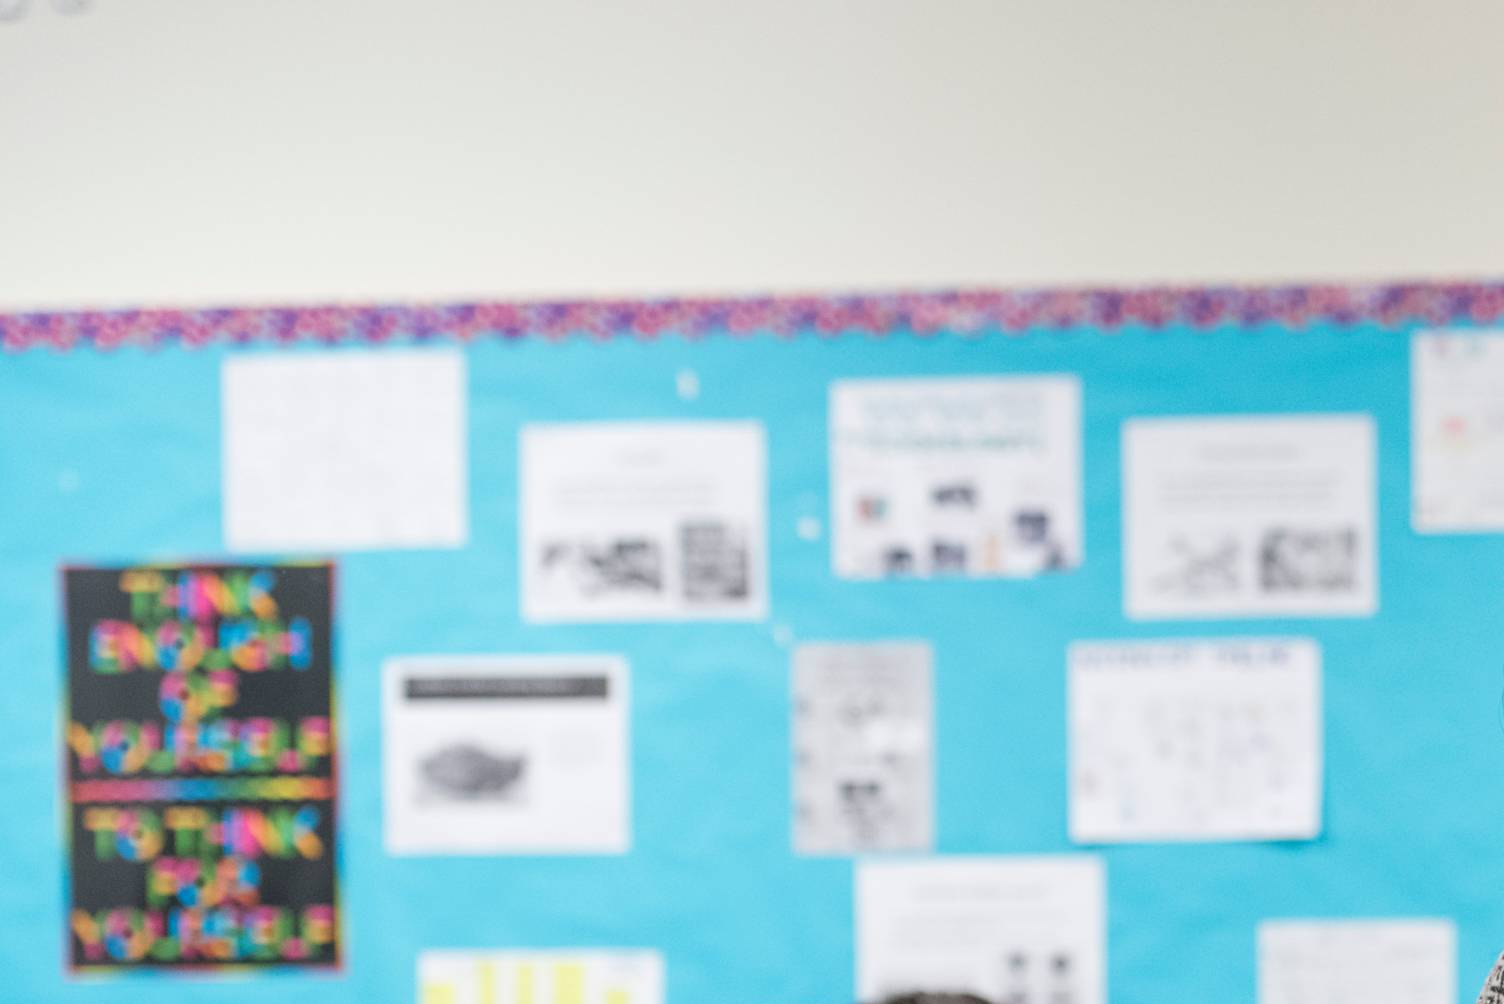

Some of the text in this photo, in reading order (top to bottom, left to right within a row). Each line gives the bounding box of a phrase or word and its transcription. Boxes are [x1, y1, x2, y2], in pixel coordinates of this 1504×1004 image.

[120, 570, 278, 620] THINK
[90, 618, 312, 673] ENOUGH
[84, 806, 323, 861] TO THINK
[146, 857, 260, 906] FOR
